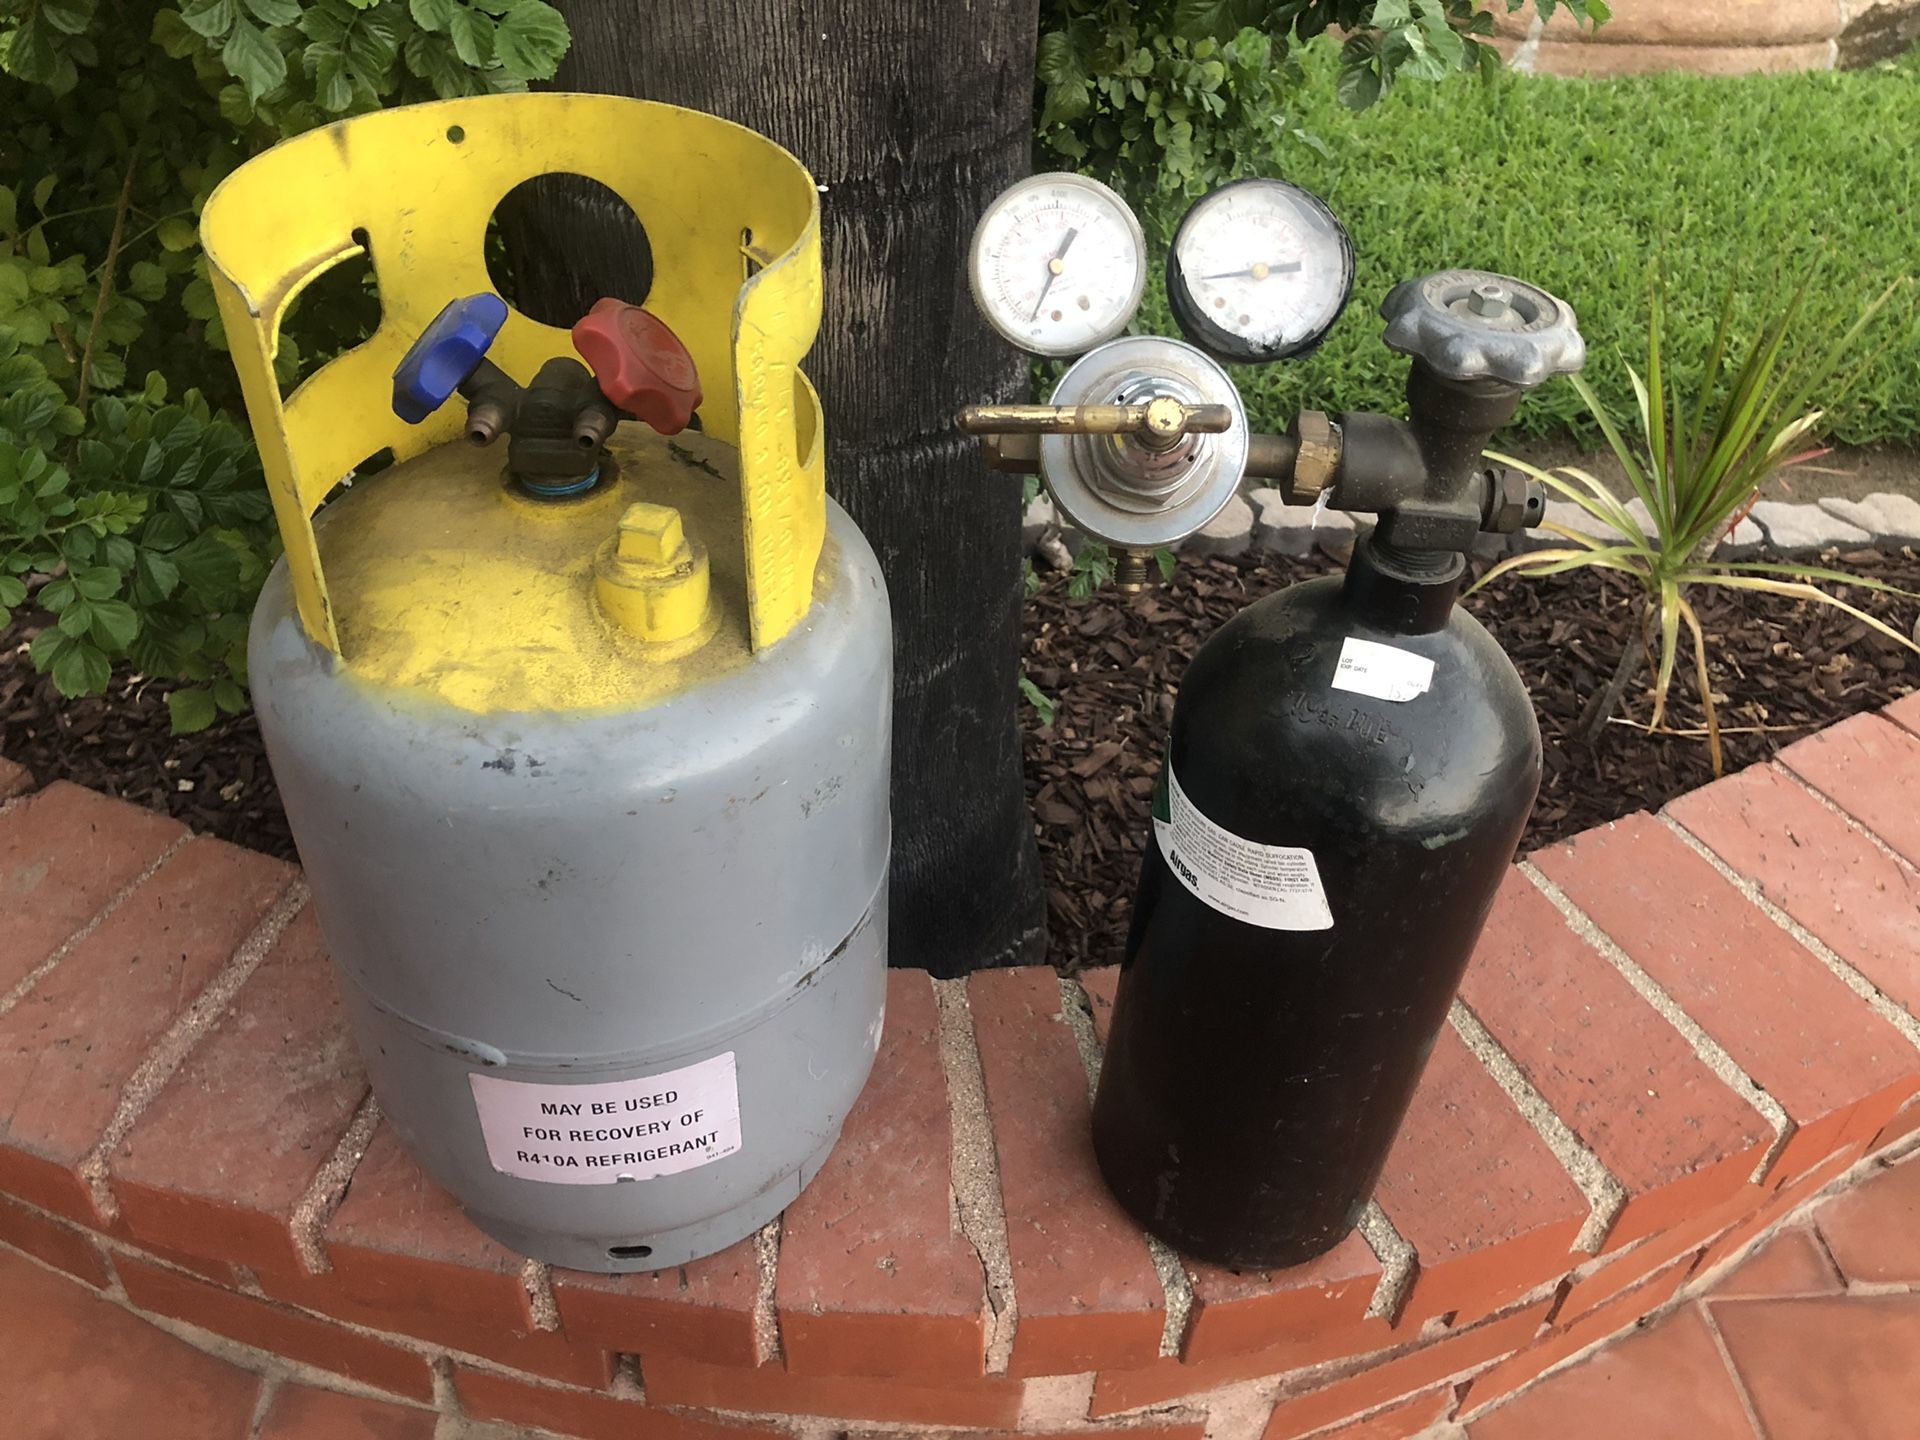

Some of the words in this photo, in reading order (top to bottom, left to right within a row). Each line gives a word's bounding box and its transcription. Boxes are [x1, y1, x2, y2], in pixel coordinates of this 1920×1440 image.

[1352, 665, 1367, 673] DATE
[541, 1101, 583, 1117] MAY
[591, 1101, 617, 1116] BE
[624, 1090, 679, 1112] USED
[523, 1126, 562, 1142] FOR
[569, 1120, 673, 1142] RECOVERY
[680, 1109, 704, 1127] OF
[517, 1150, 580, 1168] R410A
[585, 1130, 719, 1168] REFRIGERANT
